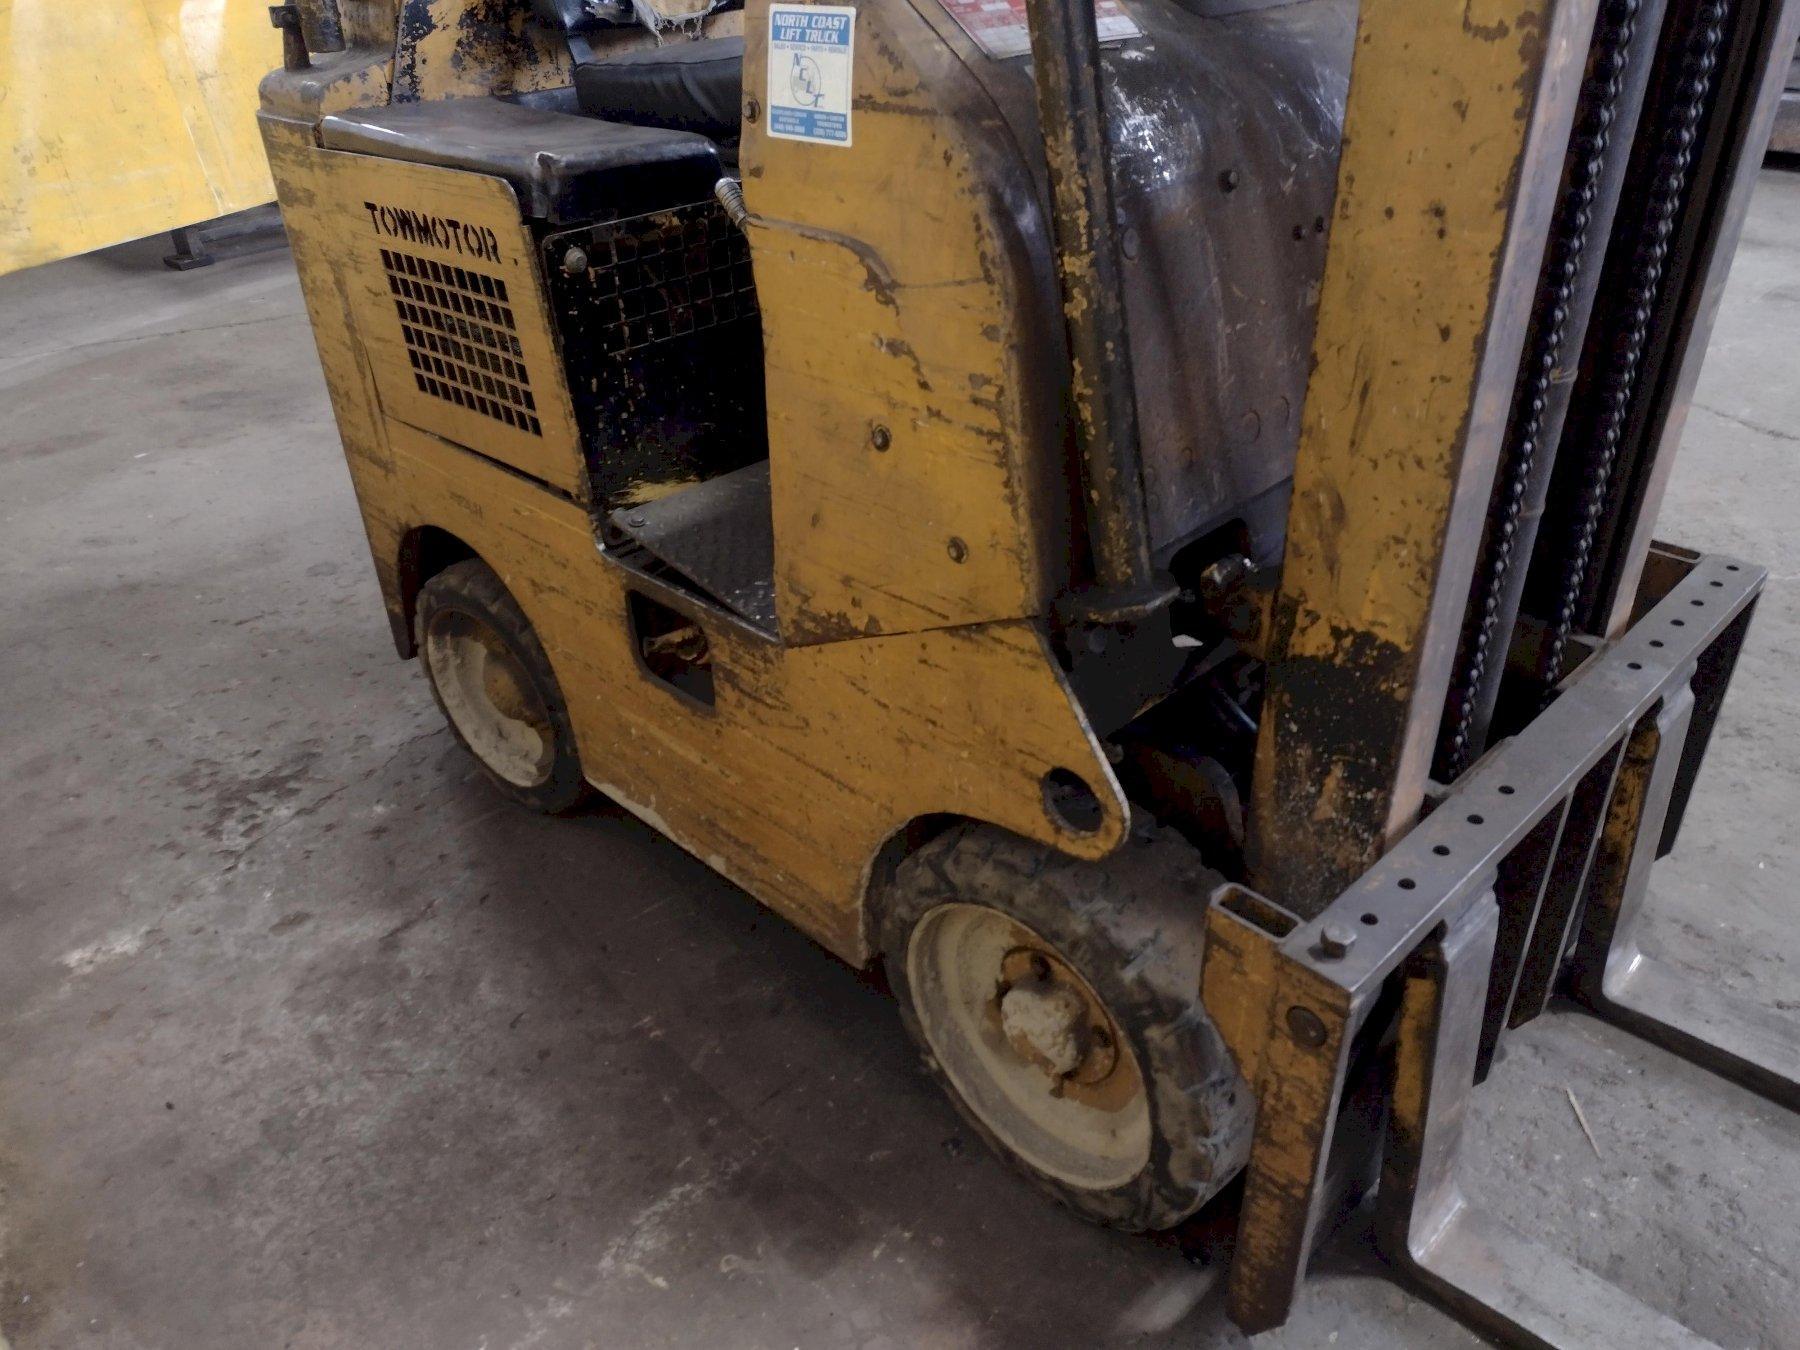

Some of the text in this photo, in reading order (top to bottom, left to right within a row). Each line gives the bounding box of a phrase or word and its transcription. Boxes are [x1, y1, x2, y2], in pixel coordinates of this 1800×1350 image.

[774, 14, 847, 29] NORTH COAST
[780, 27, 839, 43] LIFT TRUCK
[364, 201, 502, 264] TOWMOTOR
